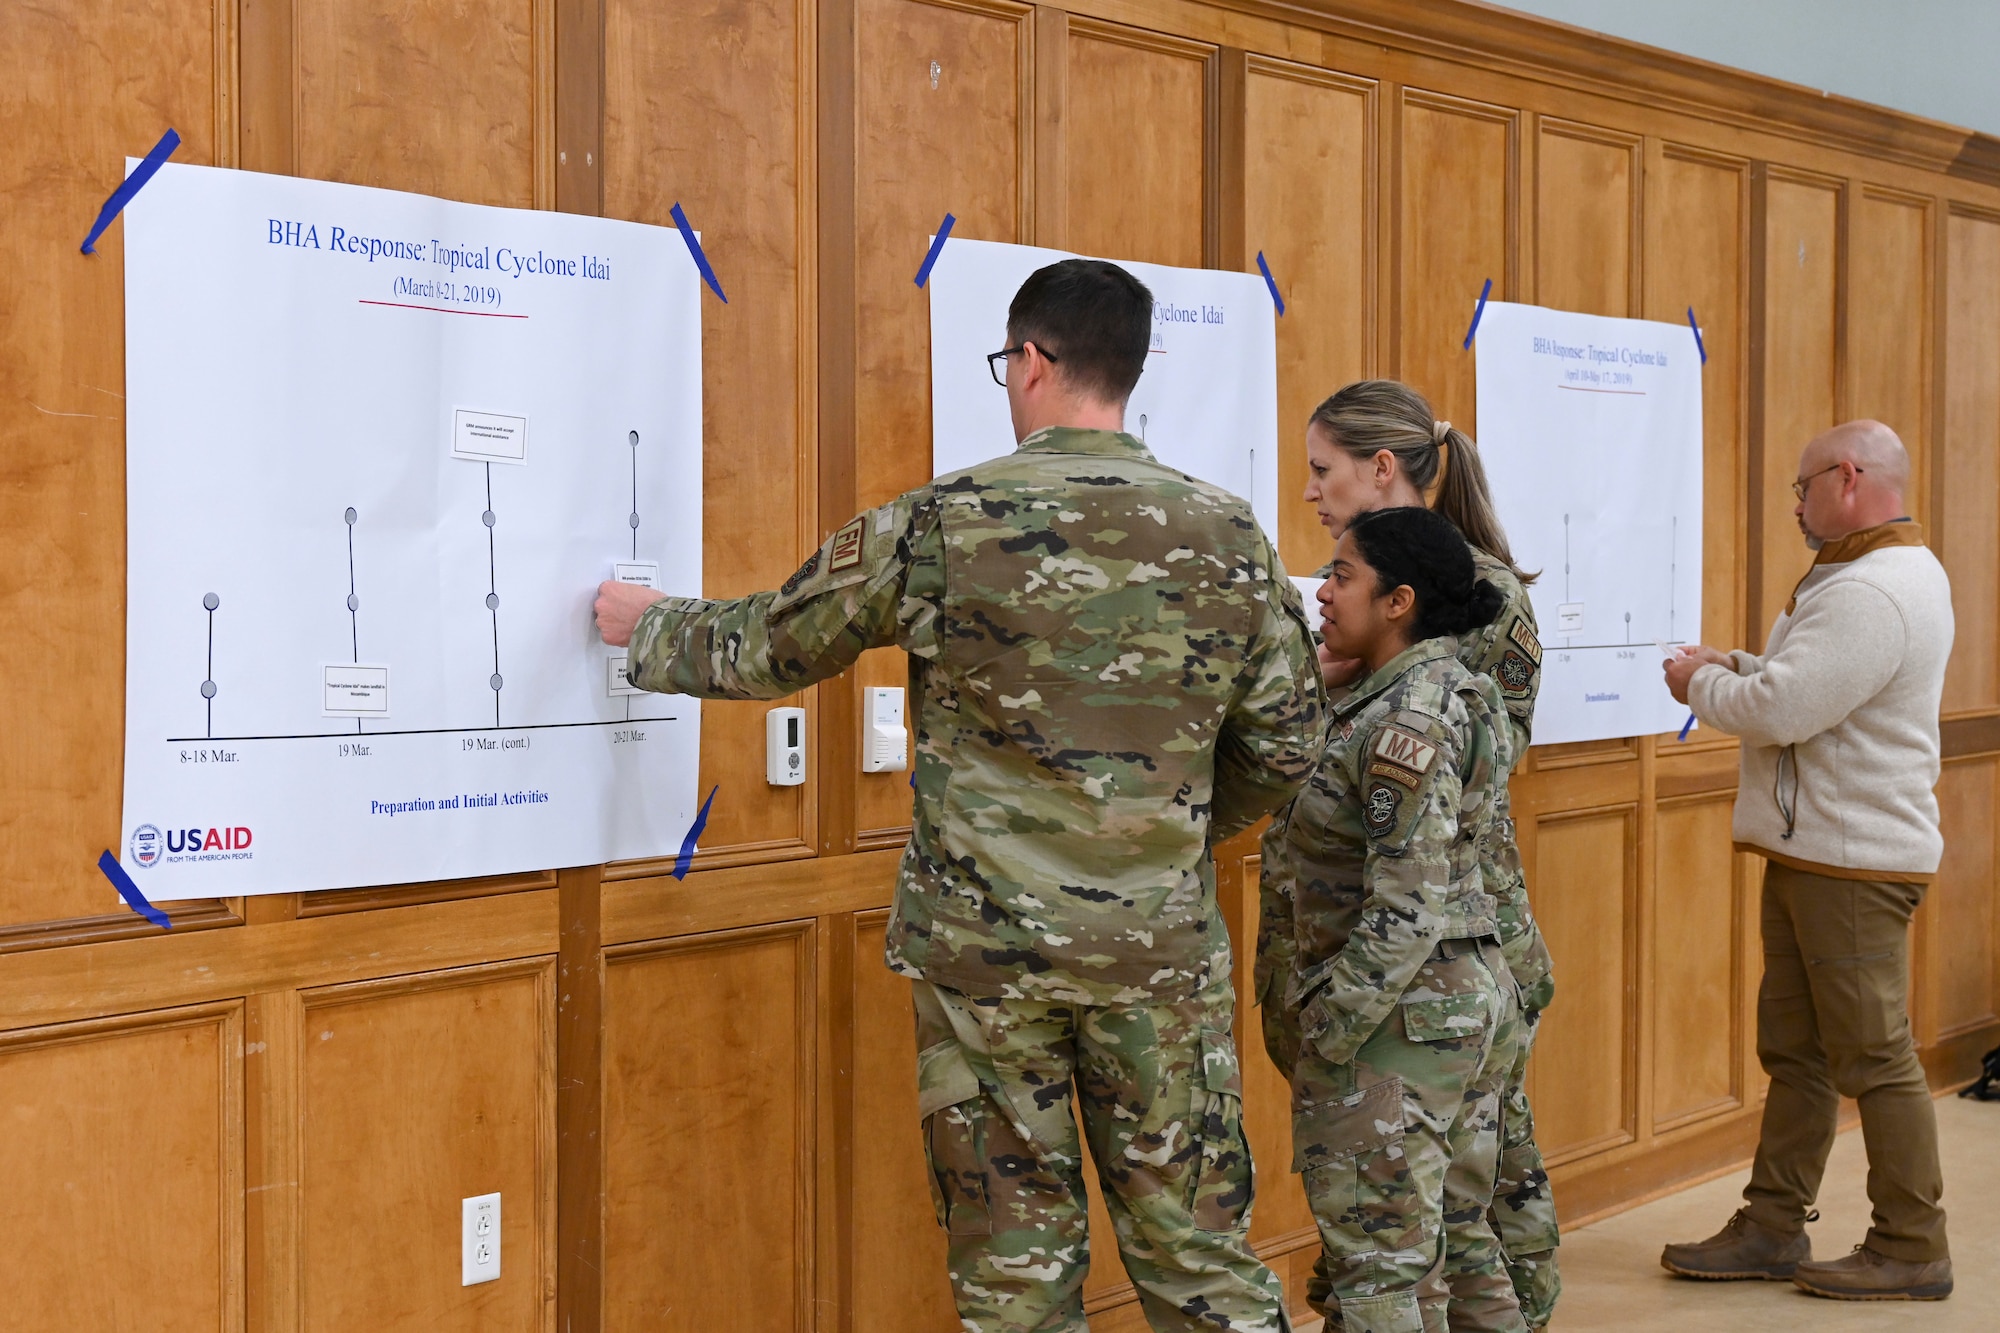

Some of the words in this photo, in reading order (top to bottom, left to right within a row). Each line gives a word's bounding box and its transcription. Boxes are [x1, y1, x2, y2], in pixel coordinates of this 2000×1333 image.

[267, 218, 321, 249] BHA
[329, 226, 426, 263] Response:
[431, 239, 490, 273] Tropical
[496, 248, 577, 279] Cyclone
[581, 255, 611, 281] Idai
[393, 275, 434, 298] (March
[436, 282, 460, 304] 8-21,
[463, 285, 502, 309] 2019)
[1153, 301, 1198, 326] Cyclone
[1202, 305, 1224, 325] Idai
[1533, 336, 1552, 355] BHA
[1588, 344, 1619, 365] Tropical
[1621, 347, 1655, 368] Cyclone
[834, 527, 860, 562] FM
[1514, 622, 1541, 659] MED
[338, 744, 350, 757] 19
[352, 743, 373, 757] Mar.
[462, 738, 474, 751] 19
[476, 738, 499, 750] Mar.
[501, 736, 531, 752] (cont.)
[614, 731, 630, 744] 20-21
[630, 729, 647, 742] Mar.
[1385, 732, 1427, 766] MX
[180, 750, 207, 763] 8-18
[211, 749, 240, 763] Mar.
[371, 797, 435, 817] Preparation
[438, 795, 459, 810] and
[463, 792, 497, 808] Initial
[500, 789, 549, 806] Activities
[167, 827, 253, 853] USAID
[167, 855, 184, 863] FROM
[199, 853, 231, 861] AMERICAN
[231, 852, 253, 860] PEOPLE
